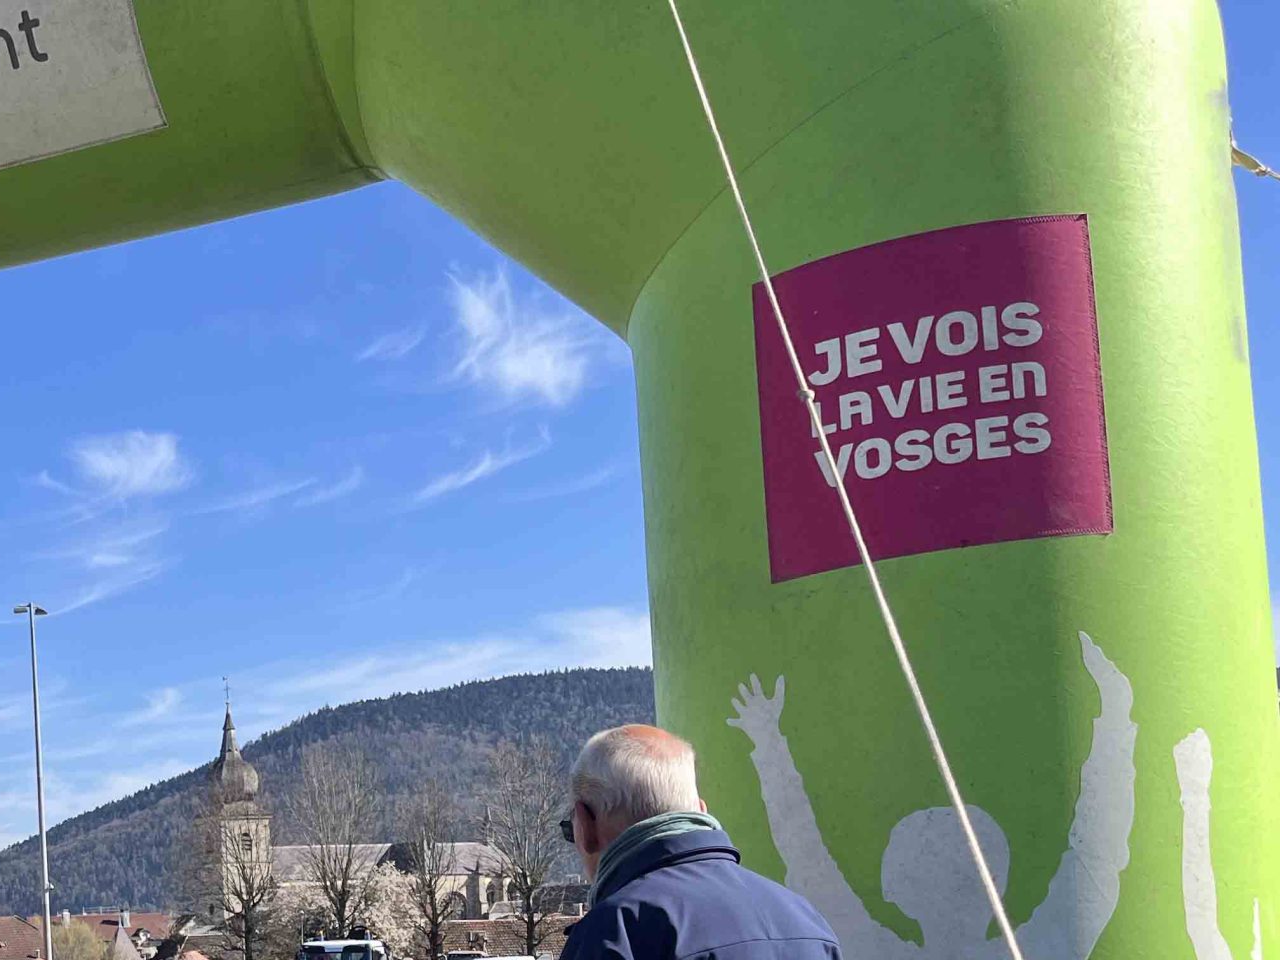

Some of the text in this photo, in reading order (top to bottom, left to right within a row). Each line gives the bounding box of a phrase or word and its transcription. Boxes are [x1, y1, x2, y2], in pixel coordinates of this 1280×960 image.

[808, 302, 1043, 386] JE VOIS
[811, 391, 873, 438] LA
[877, 371, 967, 418] VIE
[814, 412, 1052, 488] VOSGES
